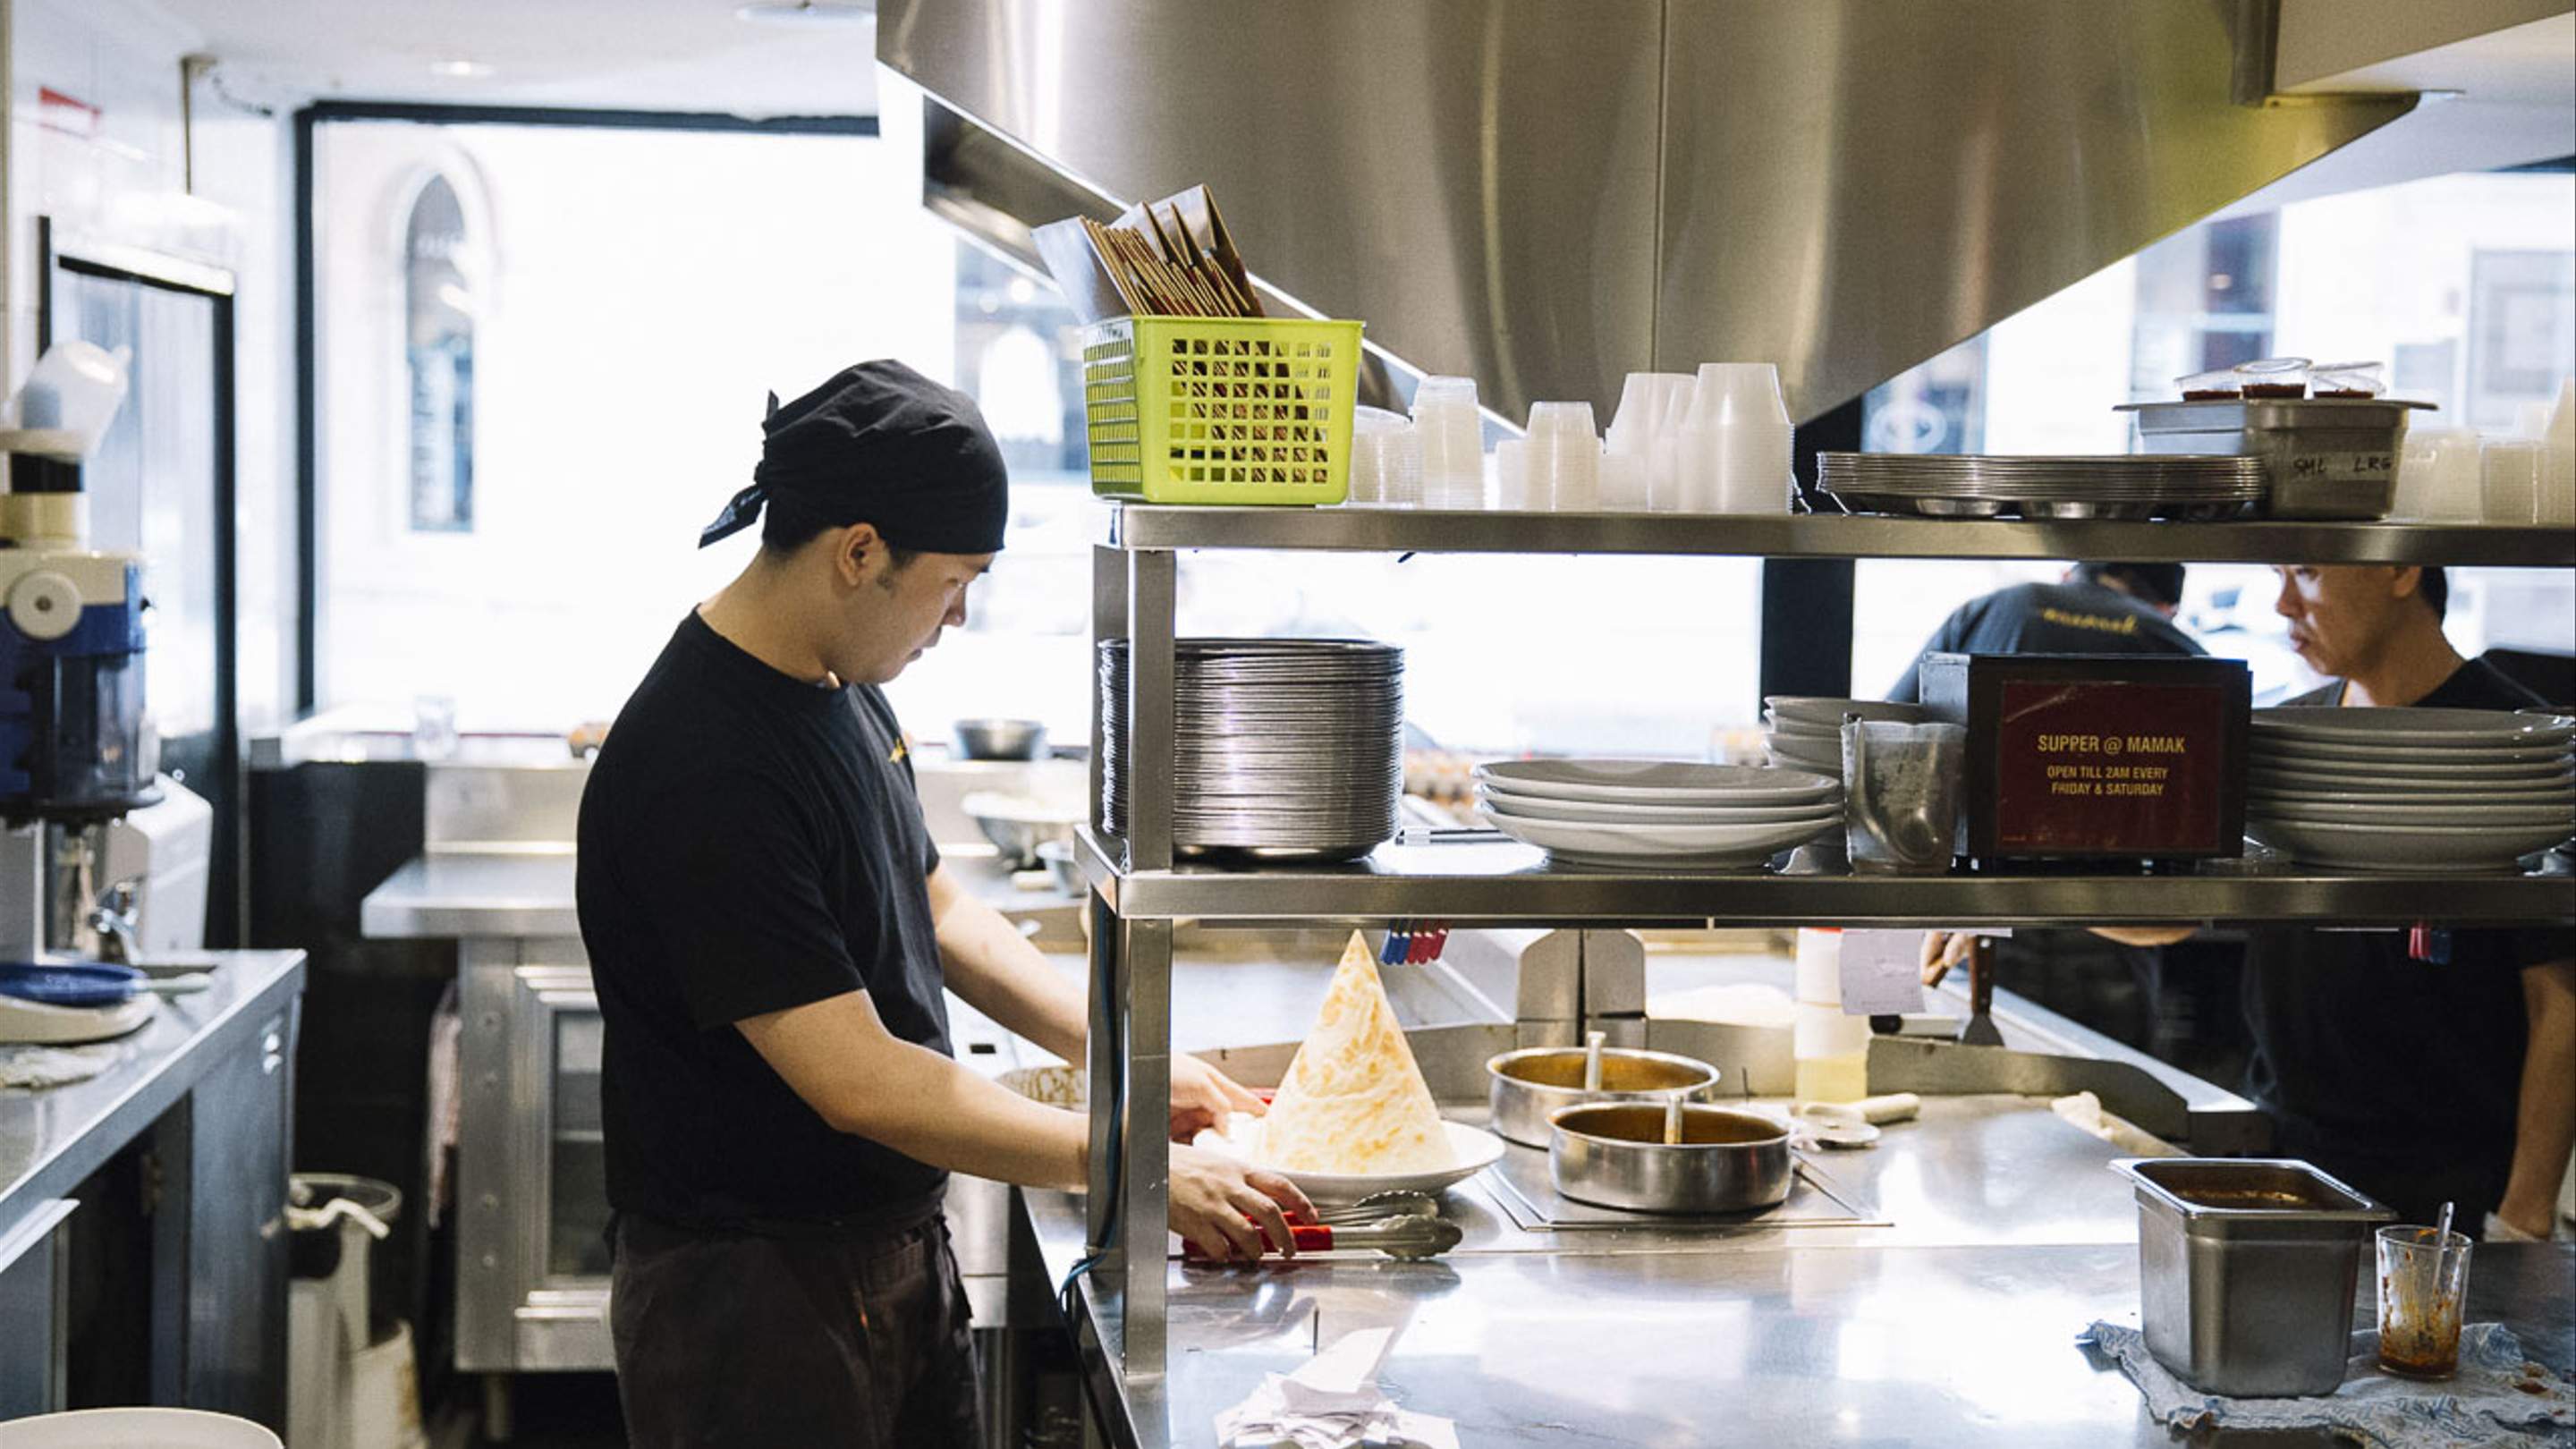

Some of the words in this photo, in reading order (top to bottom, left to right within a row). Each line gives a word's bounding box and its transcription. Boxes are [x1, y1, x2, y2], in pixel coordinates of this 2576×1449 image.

[2037, 734, 2100, 753] SUPPER
[2104, 736, 2123, 755] @
[2126, 736, 2186, 754] MAMAK
[2046, 766, 2078, 779] OPEN
[2080, 767, 2102, 779] TILL
[2106, 767, 2130, 780] 2AM
[2132, 767, 2169, 780] EVERY
[2051, 782, 2091, 795] FRIDAY
[2094, 783, 2102, 795] &
[2106, 783, 2165, 796] SATURDAY
